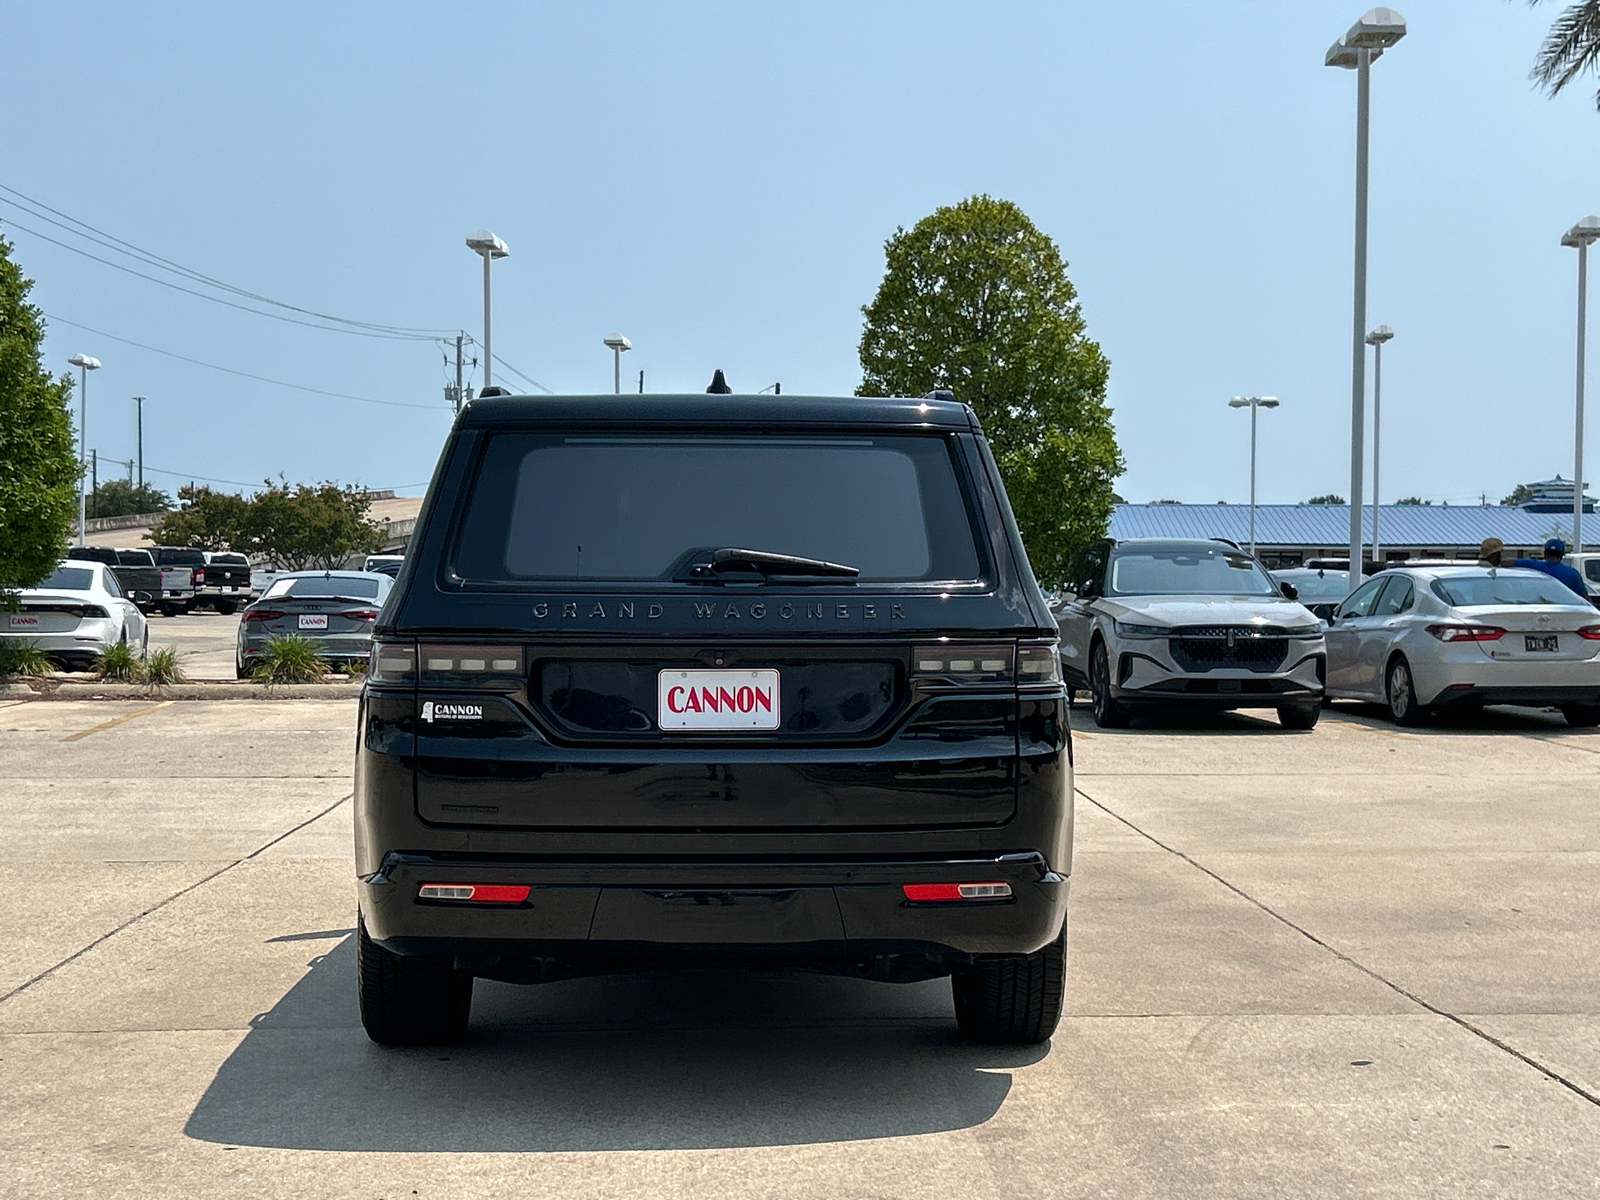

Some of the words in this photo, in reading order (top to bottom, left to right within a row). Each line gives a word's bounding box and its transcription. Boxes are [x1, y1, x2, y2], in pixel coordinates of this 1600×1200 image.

[532, 602, 663, 618] GRAND
[694, 602, 905, 619] WAGONEER
[12, 617, 38, 625] CANNON
[667, 685, 771, 713] CANNON
[434, 704, 483, 715] CANNON
